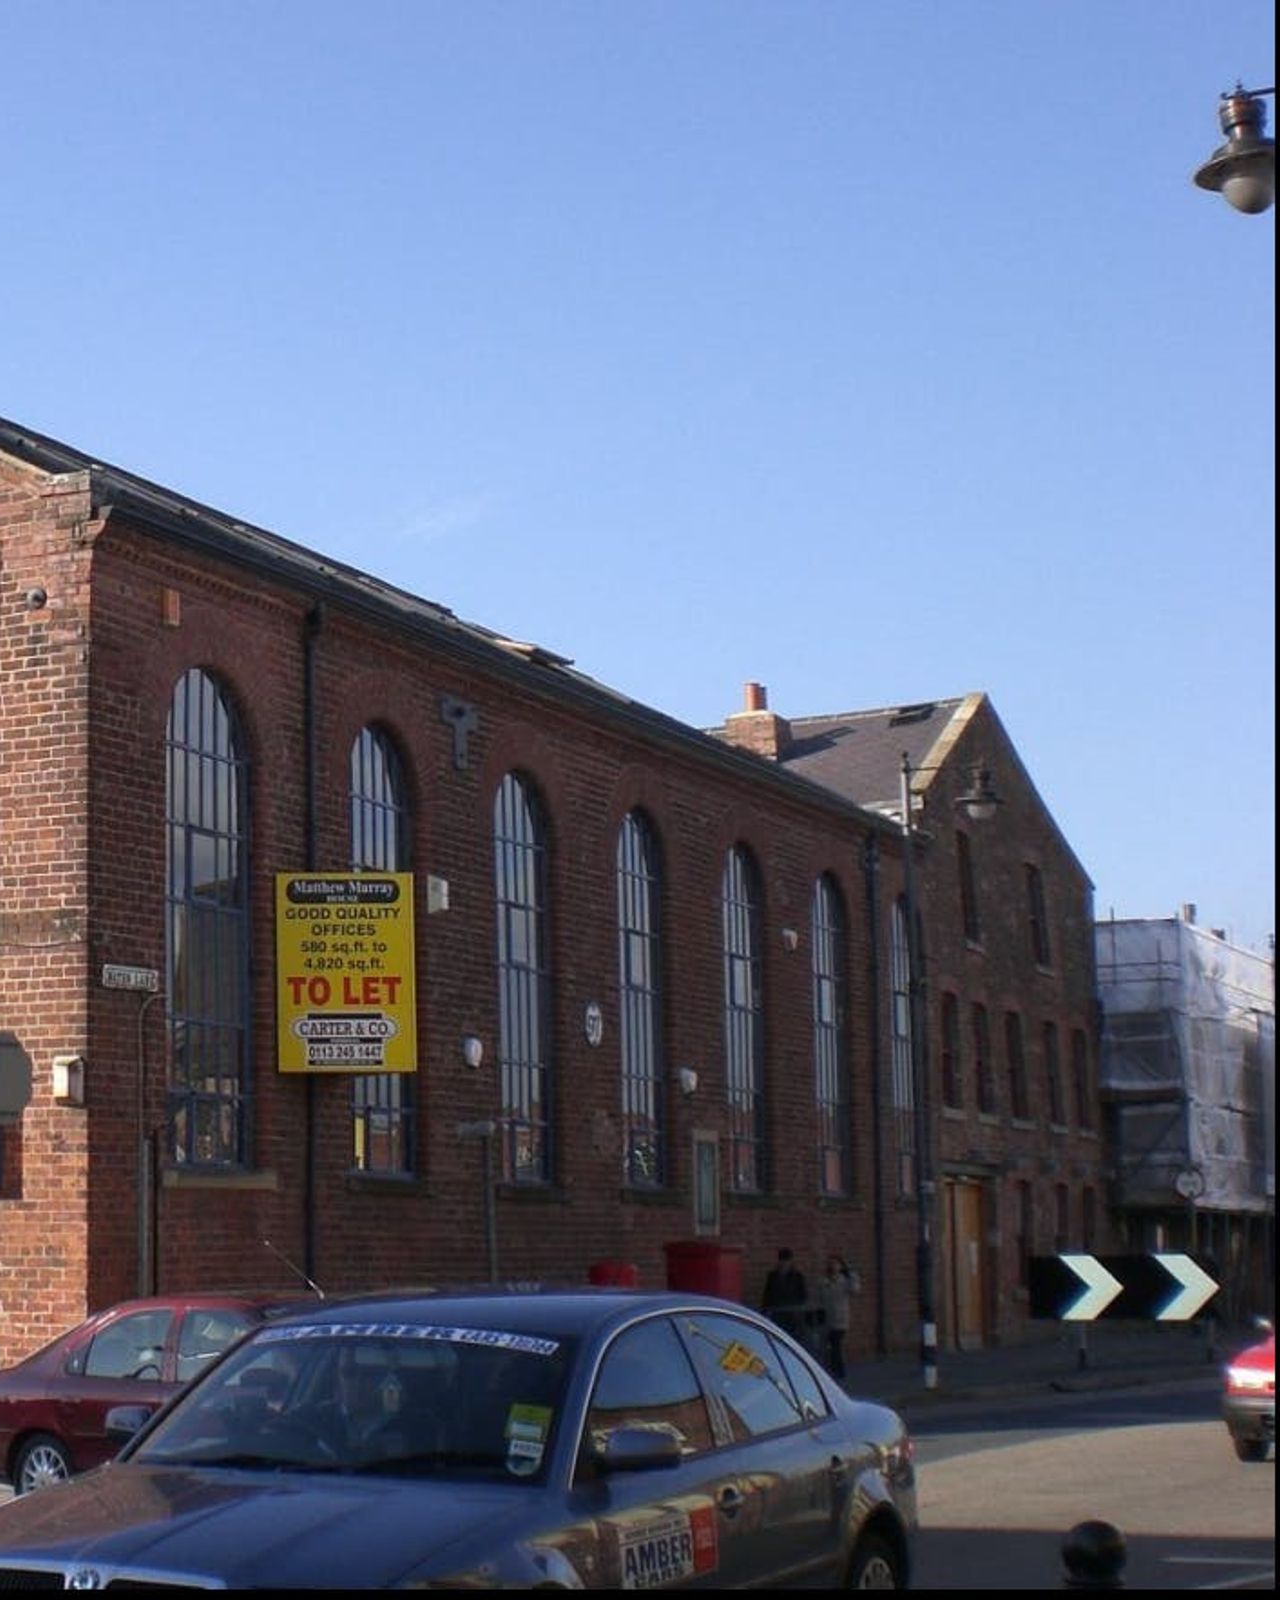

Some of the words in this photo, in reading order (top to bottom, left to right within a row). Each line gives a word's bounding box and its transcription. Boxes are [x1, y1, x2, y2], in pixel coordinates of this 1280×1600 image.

[294, 881, 344, 893] Matthew
[349, 882, 394, 897] Murray
[285, 907, 331, 920] GOOD
[335, 907, 401, 920] QUALITY
[311, 924, 376, 936] OFFICES
[300, 941, 327, 953] 580
[331, 942, 368, 955] sq.ft.
[372, 942, 388, 953] to
[347, 958, 385, 972] sq.ft.
[286, 976, 331, 1006] TO
[343, 976, 402, 1005] LET
[299, 1022, 352, 1036] CARTER
[355, 1023, 365, 1035] &
[308, 1046, 334, 1058] 0113
[336, 1046, 356, 1058] 245
[625, 1532, 692, 1580] AMBER
